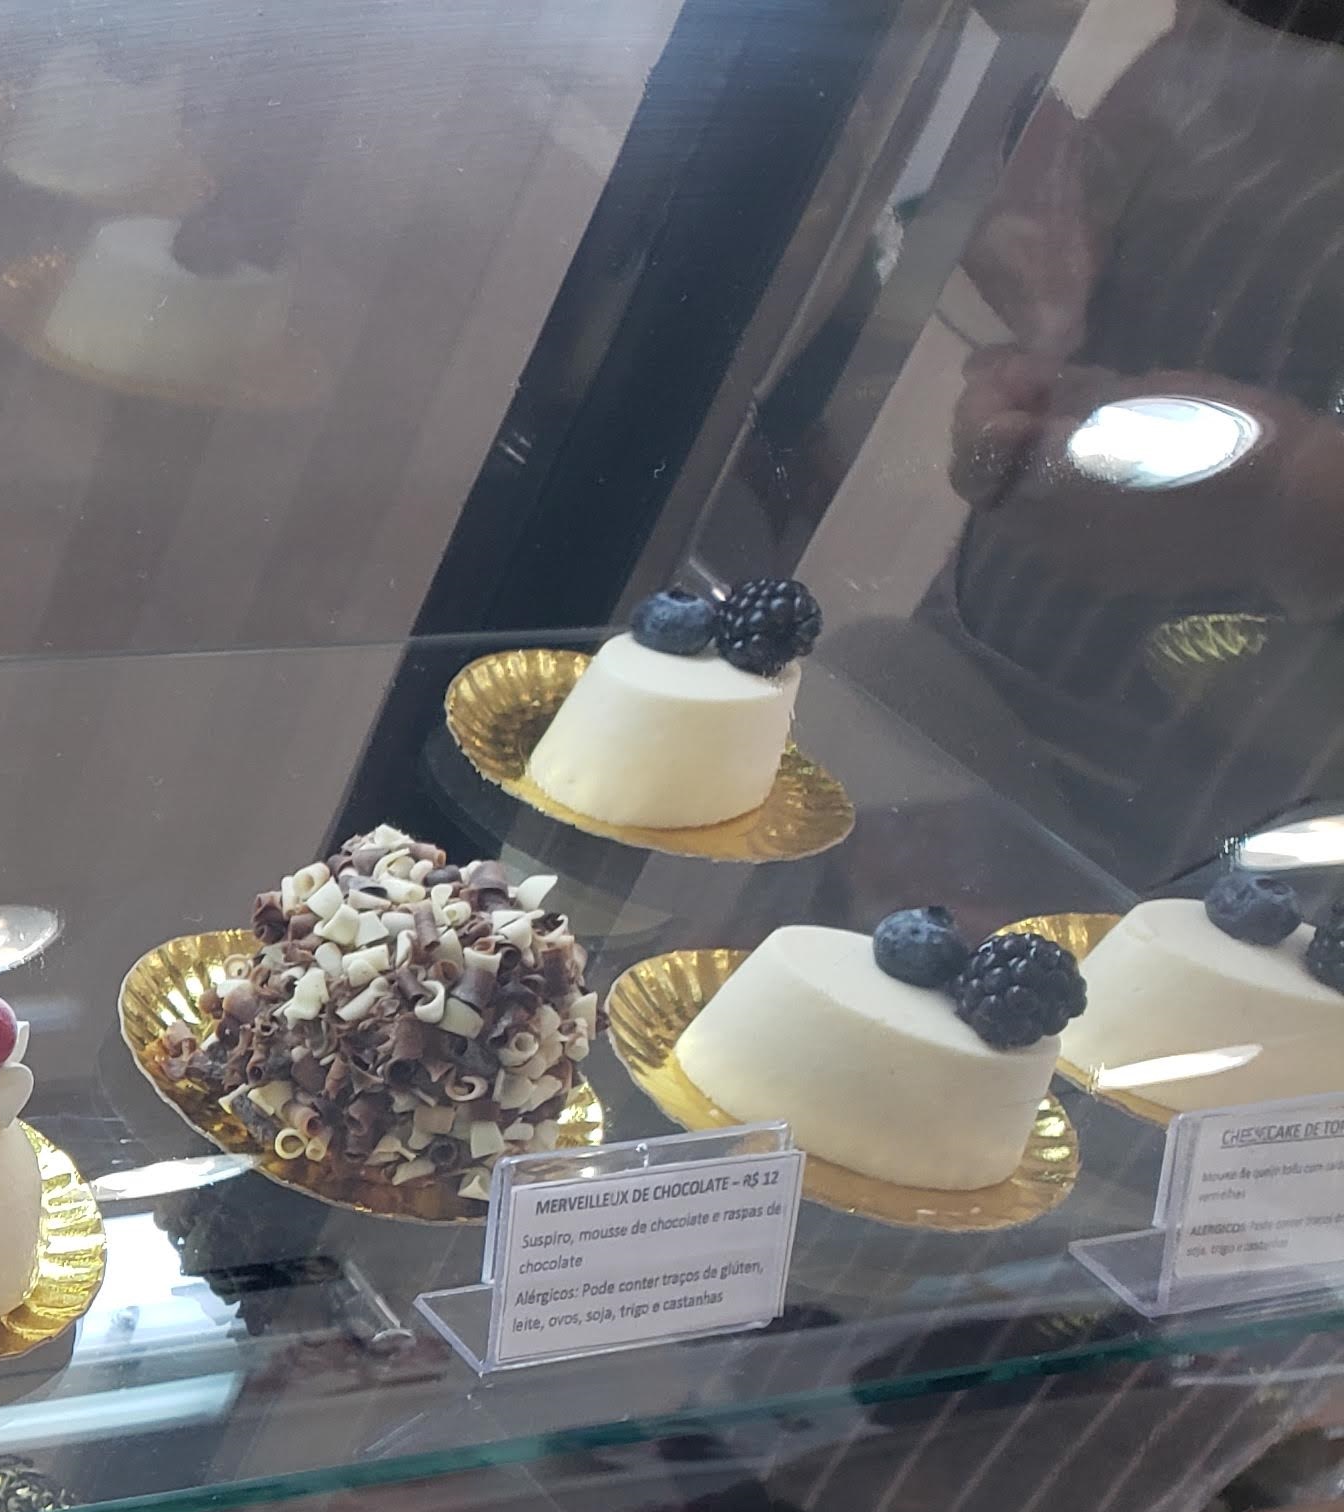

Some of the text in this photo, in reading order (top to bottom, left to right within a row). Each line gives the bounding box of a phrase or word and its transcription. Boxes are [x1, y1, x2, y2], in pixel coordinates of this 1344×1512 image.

[536, 1190, 628, 1215] MERVEILLEUX
[632, 1187, 650, 1203] DE
[653, 1177, 730, 1200] CHOCOLATE
[743, 1172, 759, 1188] R$
[762, 1171, 779, 1185] 12
[522, 1201, 781, 1249] Suspiro, mousse de chocolate e raspas de
[519, 1255, 582, 1274] chocolate
[582, 1280, 614, 1297] Pode
[619, 1277, 660, 1292] conter
[663, 1271, 699, 1286] traços
[703, 1265, 717, 1279] de
[513, 1290, 723, 1332] leite, ovos, soja, trigo e castanhas
